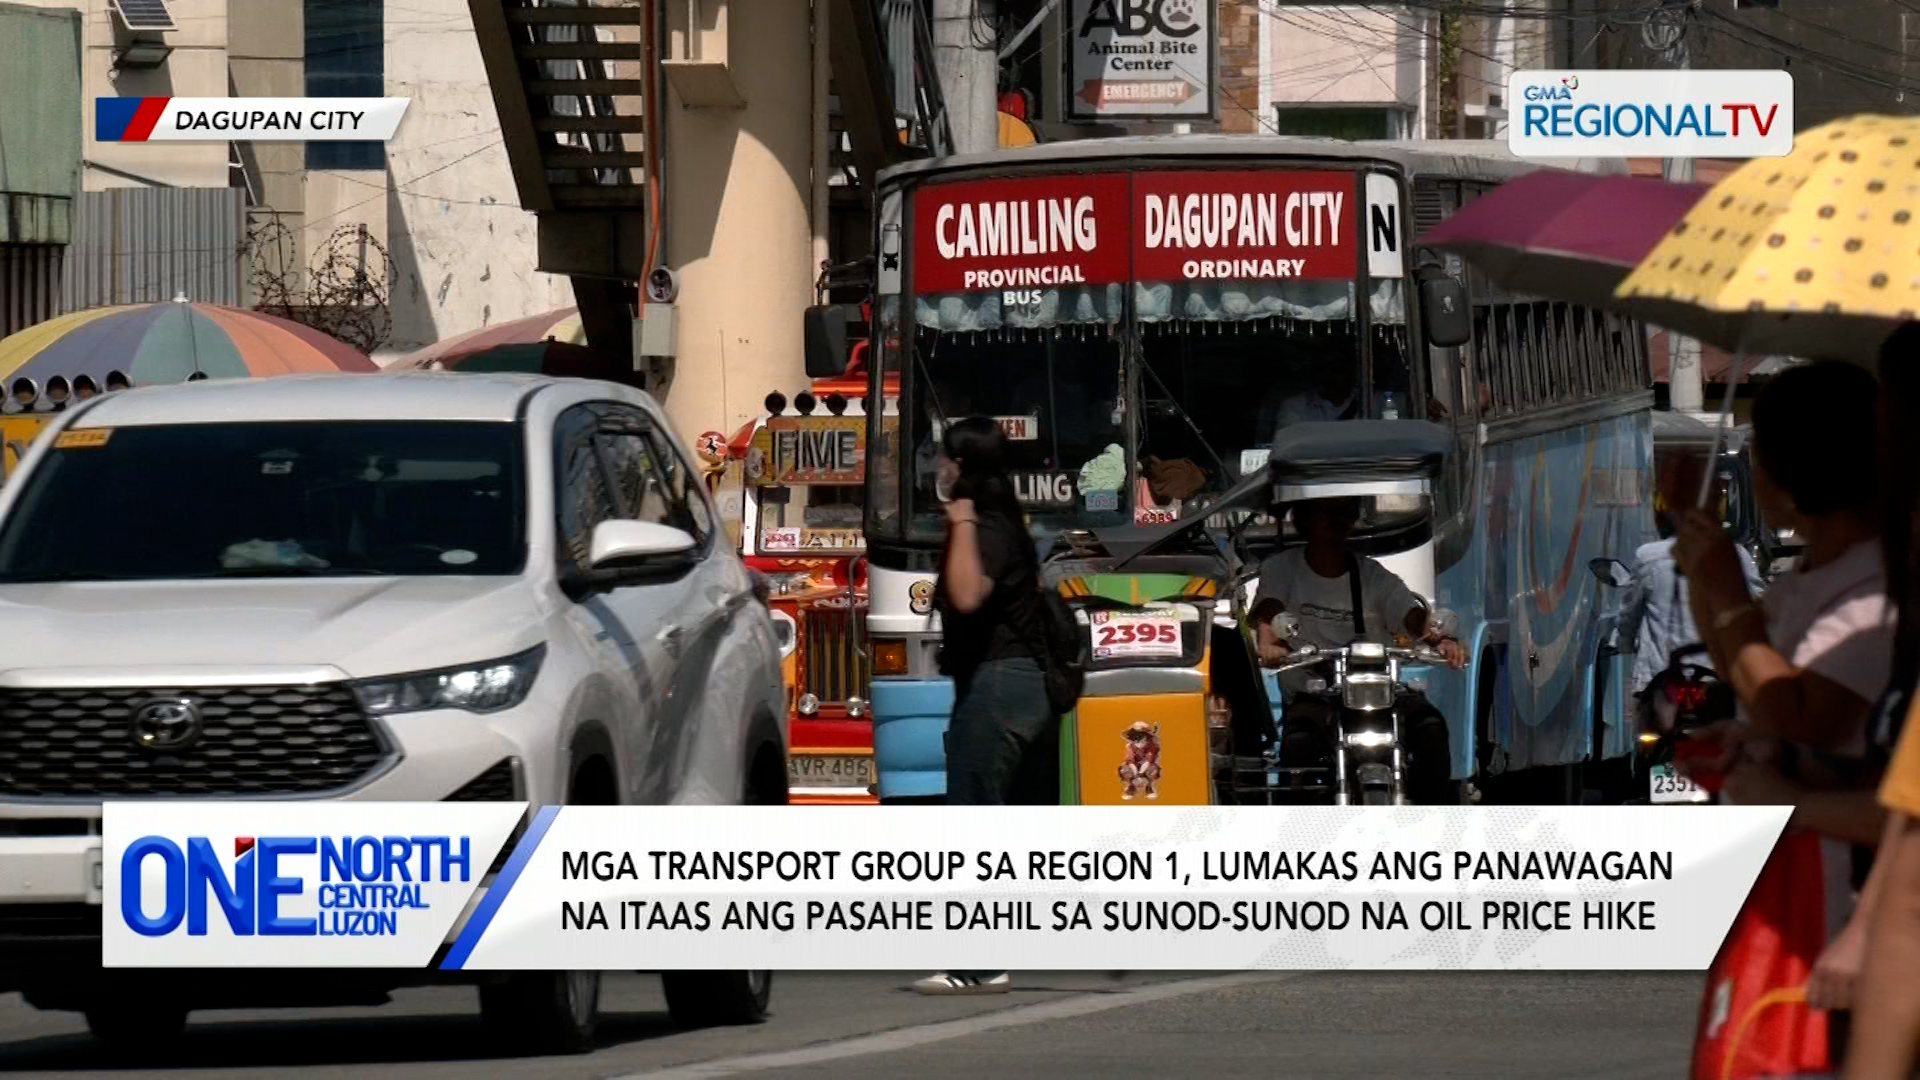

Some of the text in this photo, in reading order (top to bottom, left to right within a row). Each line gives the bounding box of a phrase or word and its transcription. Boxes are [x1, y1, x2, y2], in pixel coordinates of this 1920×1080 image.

[1079, 0, 1201, 38] ABC
[1088, 41, 1198, 55] Animal Bite
[1111, 57, 1173, 71] Center
[1103, 82, 1185, 100] EMERGENCY
[935, 195, 1097, 260] CAMILING
[1145, 191, 1344, 249] DAGUPAN CITY
[1370, 203, 1397, 252] N
[964, 264, 1085, 289] PROVINCIAL
[1182, 258, 1306, 279] ORDINARY
[1002, 289, 1043, 306] BUS
[773, 429, 858, 473] FIVE
[1012, 473, 1073, 502] LING
[1098, 623, 1178, 646] 2395
